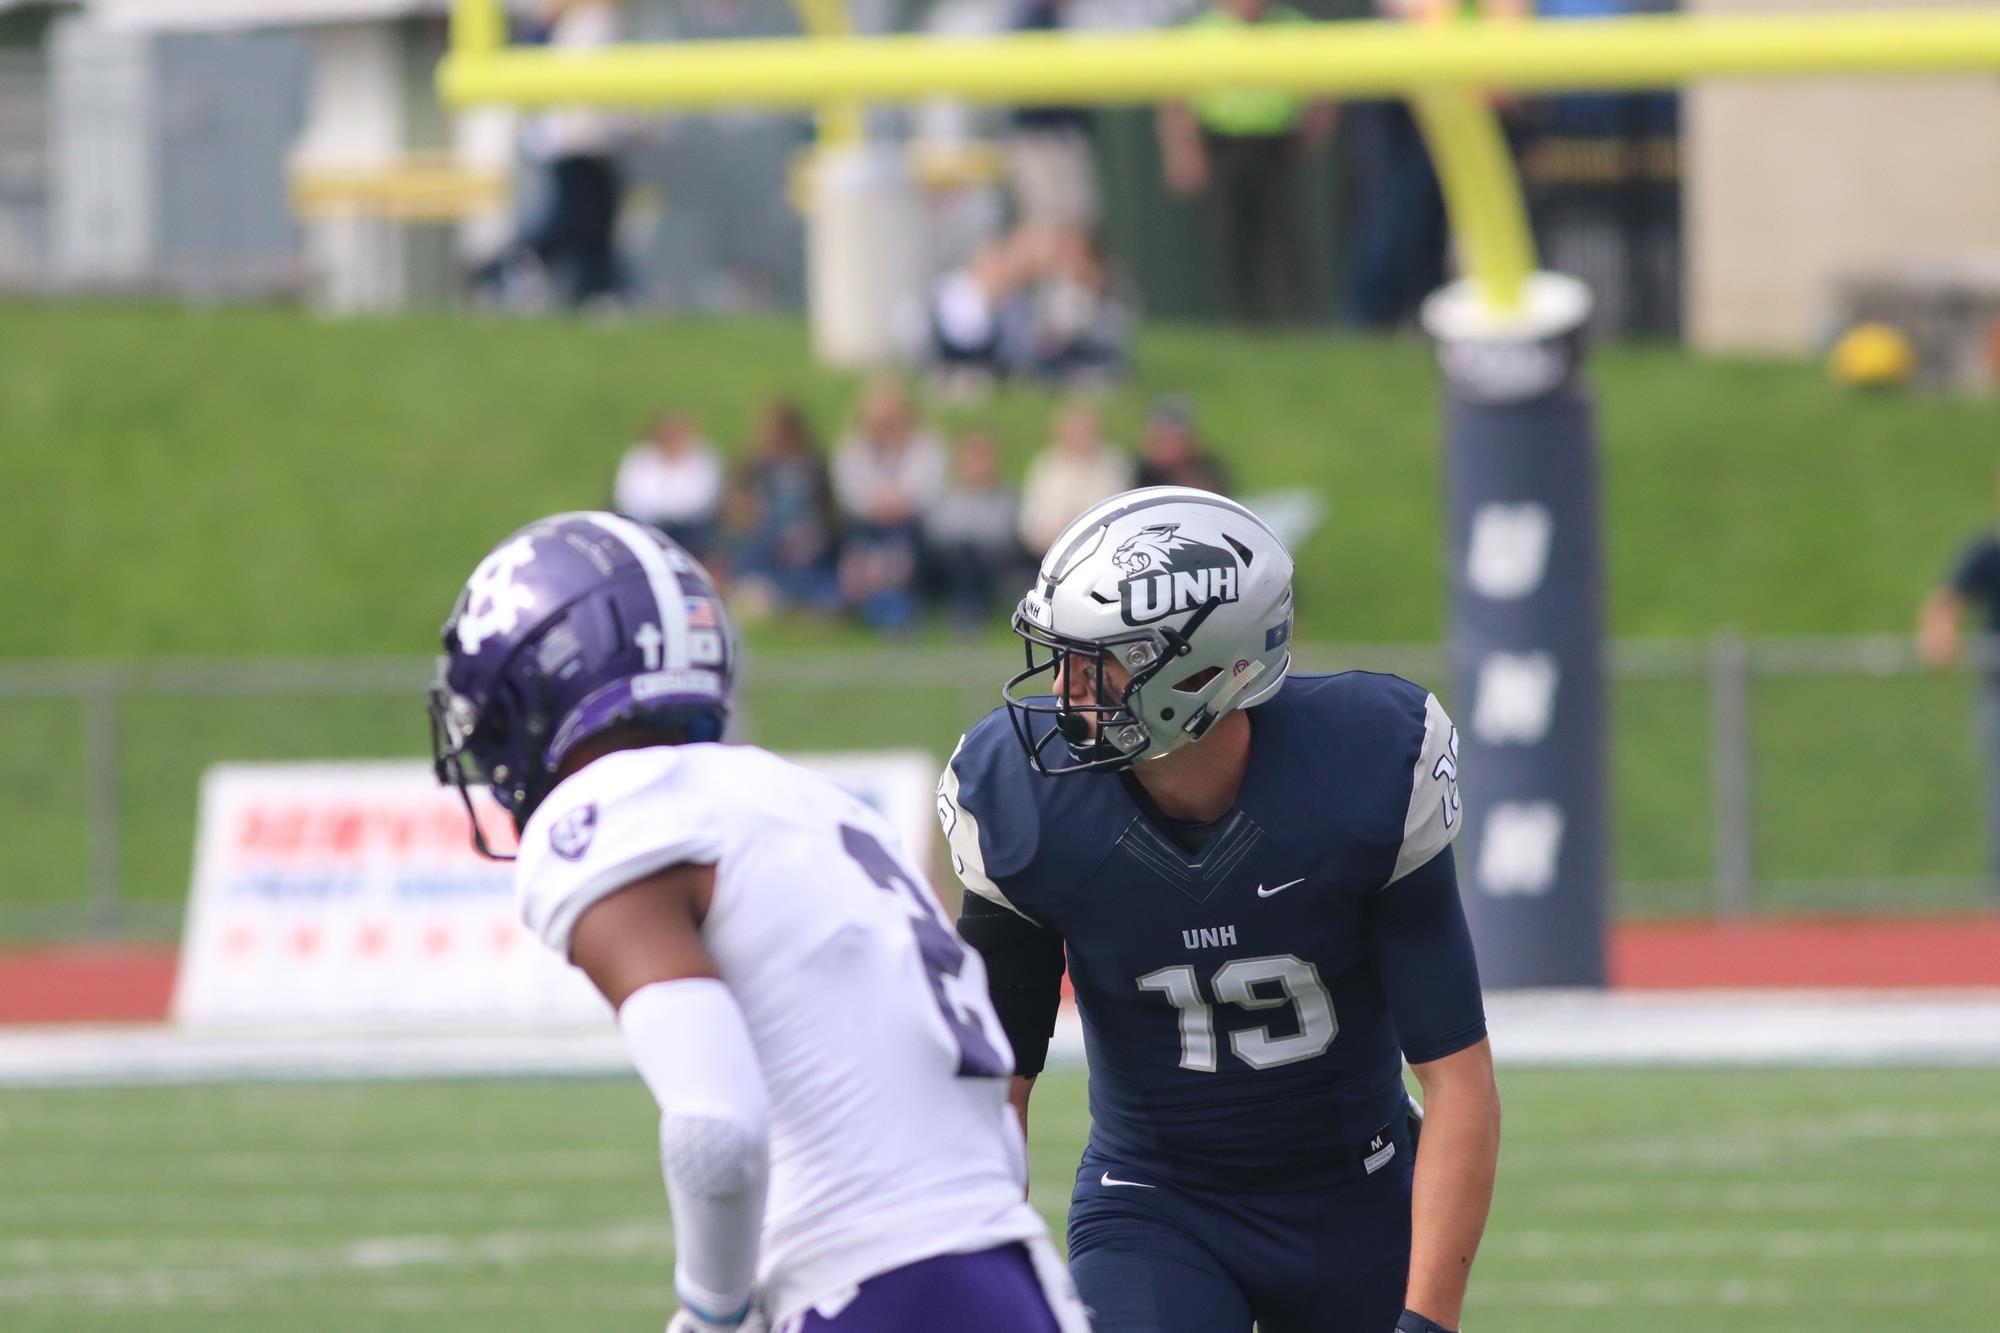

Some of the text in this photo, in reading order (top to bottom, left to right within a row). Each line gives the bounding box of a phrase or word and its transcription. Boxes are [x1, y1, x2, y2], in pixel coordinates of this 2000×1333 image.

[1128, 566, 1237, 622] UNH
[839, 823, 1007, 1077] 2
[1182, 924, 1238, 950] UNH
[1135, 954, 1340, 1073] 19
[1370, 1135, 1383, 1152] M
